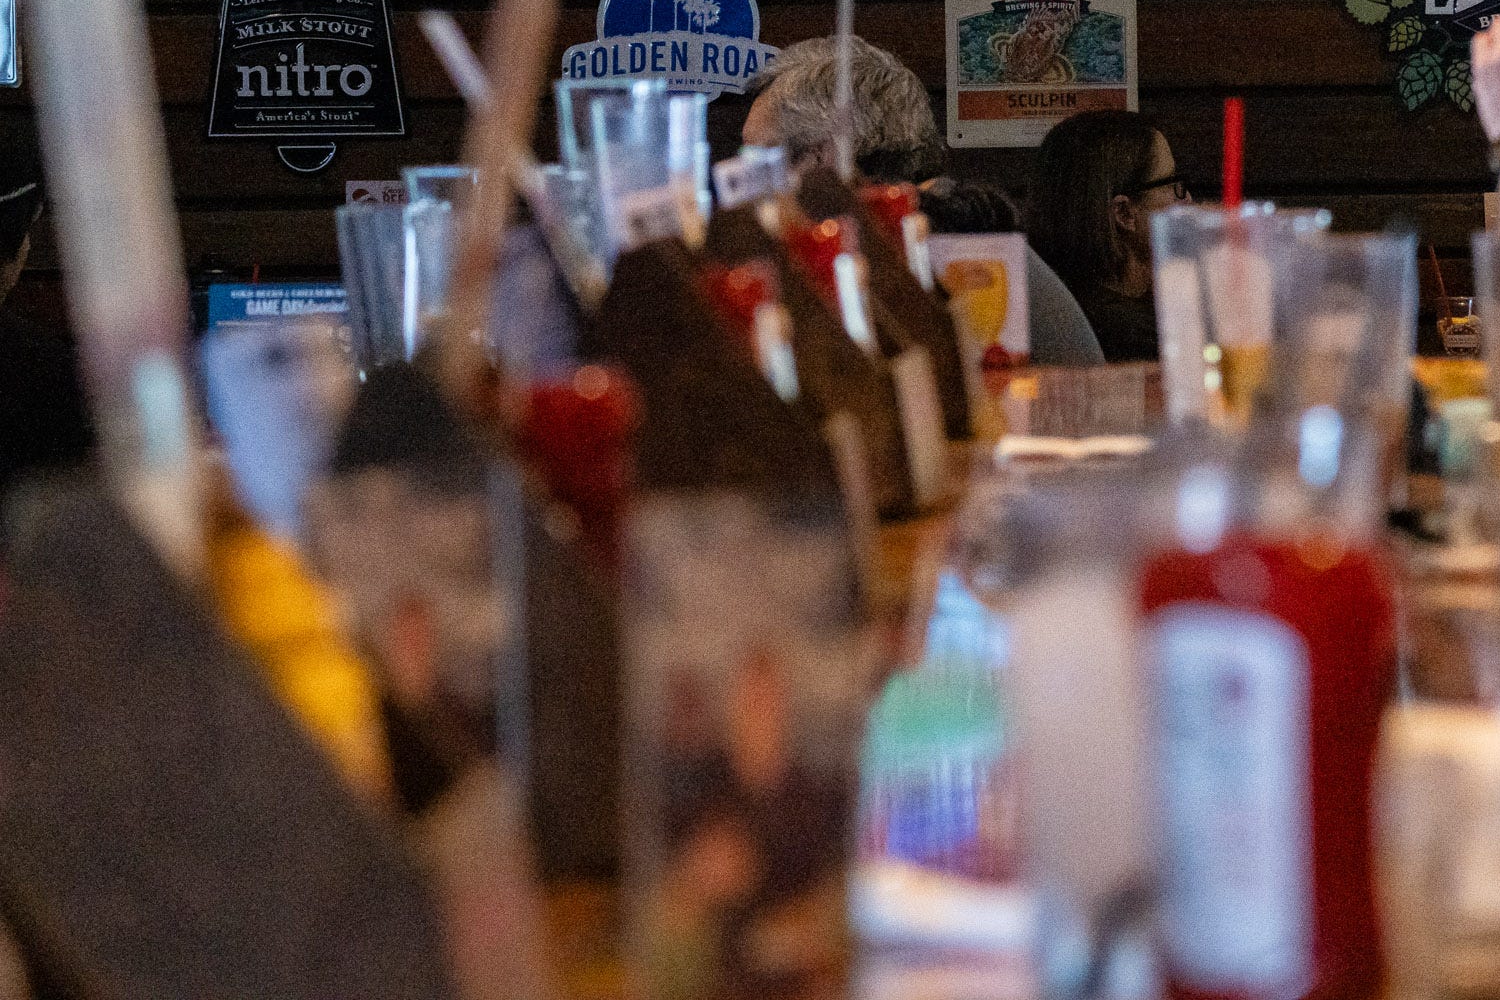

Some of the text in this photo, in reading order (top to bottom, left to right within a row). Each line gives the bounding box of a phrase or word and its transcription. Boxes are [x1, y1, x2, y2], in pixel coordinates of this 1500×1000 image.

[236, 17, 373, 40] MILK STOUT
[236, 41, 373, 97] nitro
[570, 41, 689, 79] GOLDEN
[667, 78, 704, 86] EWING
[1007, 93, 1078, 109] SCULPIN
[256, 110, 354, 122] America's Stout
